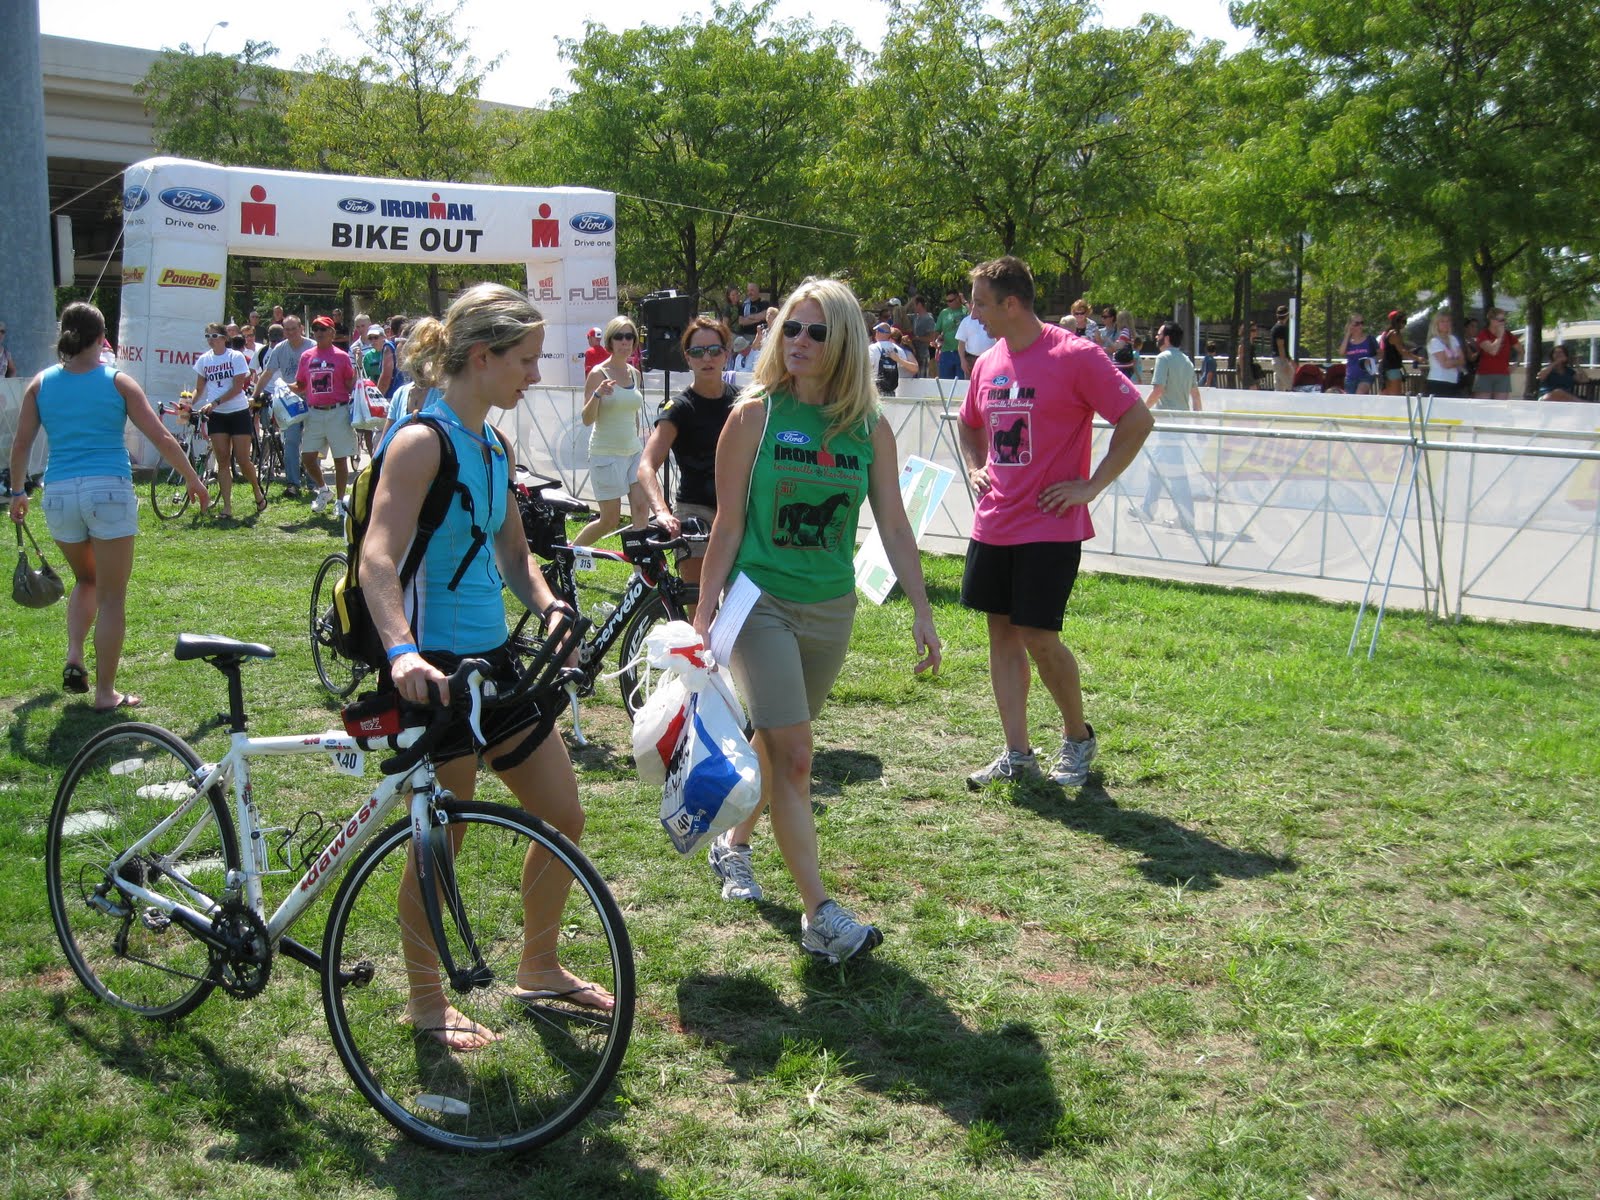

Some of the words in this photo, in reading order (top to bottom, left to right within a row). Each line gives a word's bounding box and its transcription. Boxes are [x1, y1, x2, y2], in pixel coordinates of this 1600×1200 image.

[380, 193, 474, 221] IRONMAN
[165, 217, 194, 228] Drive
[197, 223, 220, 232] one.
[331, 222, 409, 251] BIKE
[419, 227, 484, 253] OUT
[574, 239, 595, 247] Drive
[162, 269, 219, 288] PowerBar
[568, 287, 616, 301] FUEL
[774, 444, 860, 471] IRONMAN
[335, 752, 358, 770] 140
[305, 804, 371, 887] dawes
